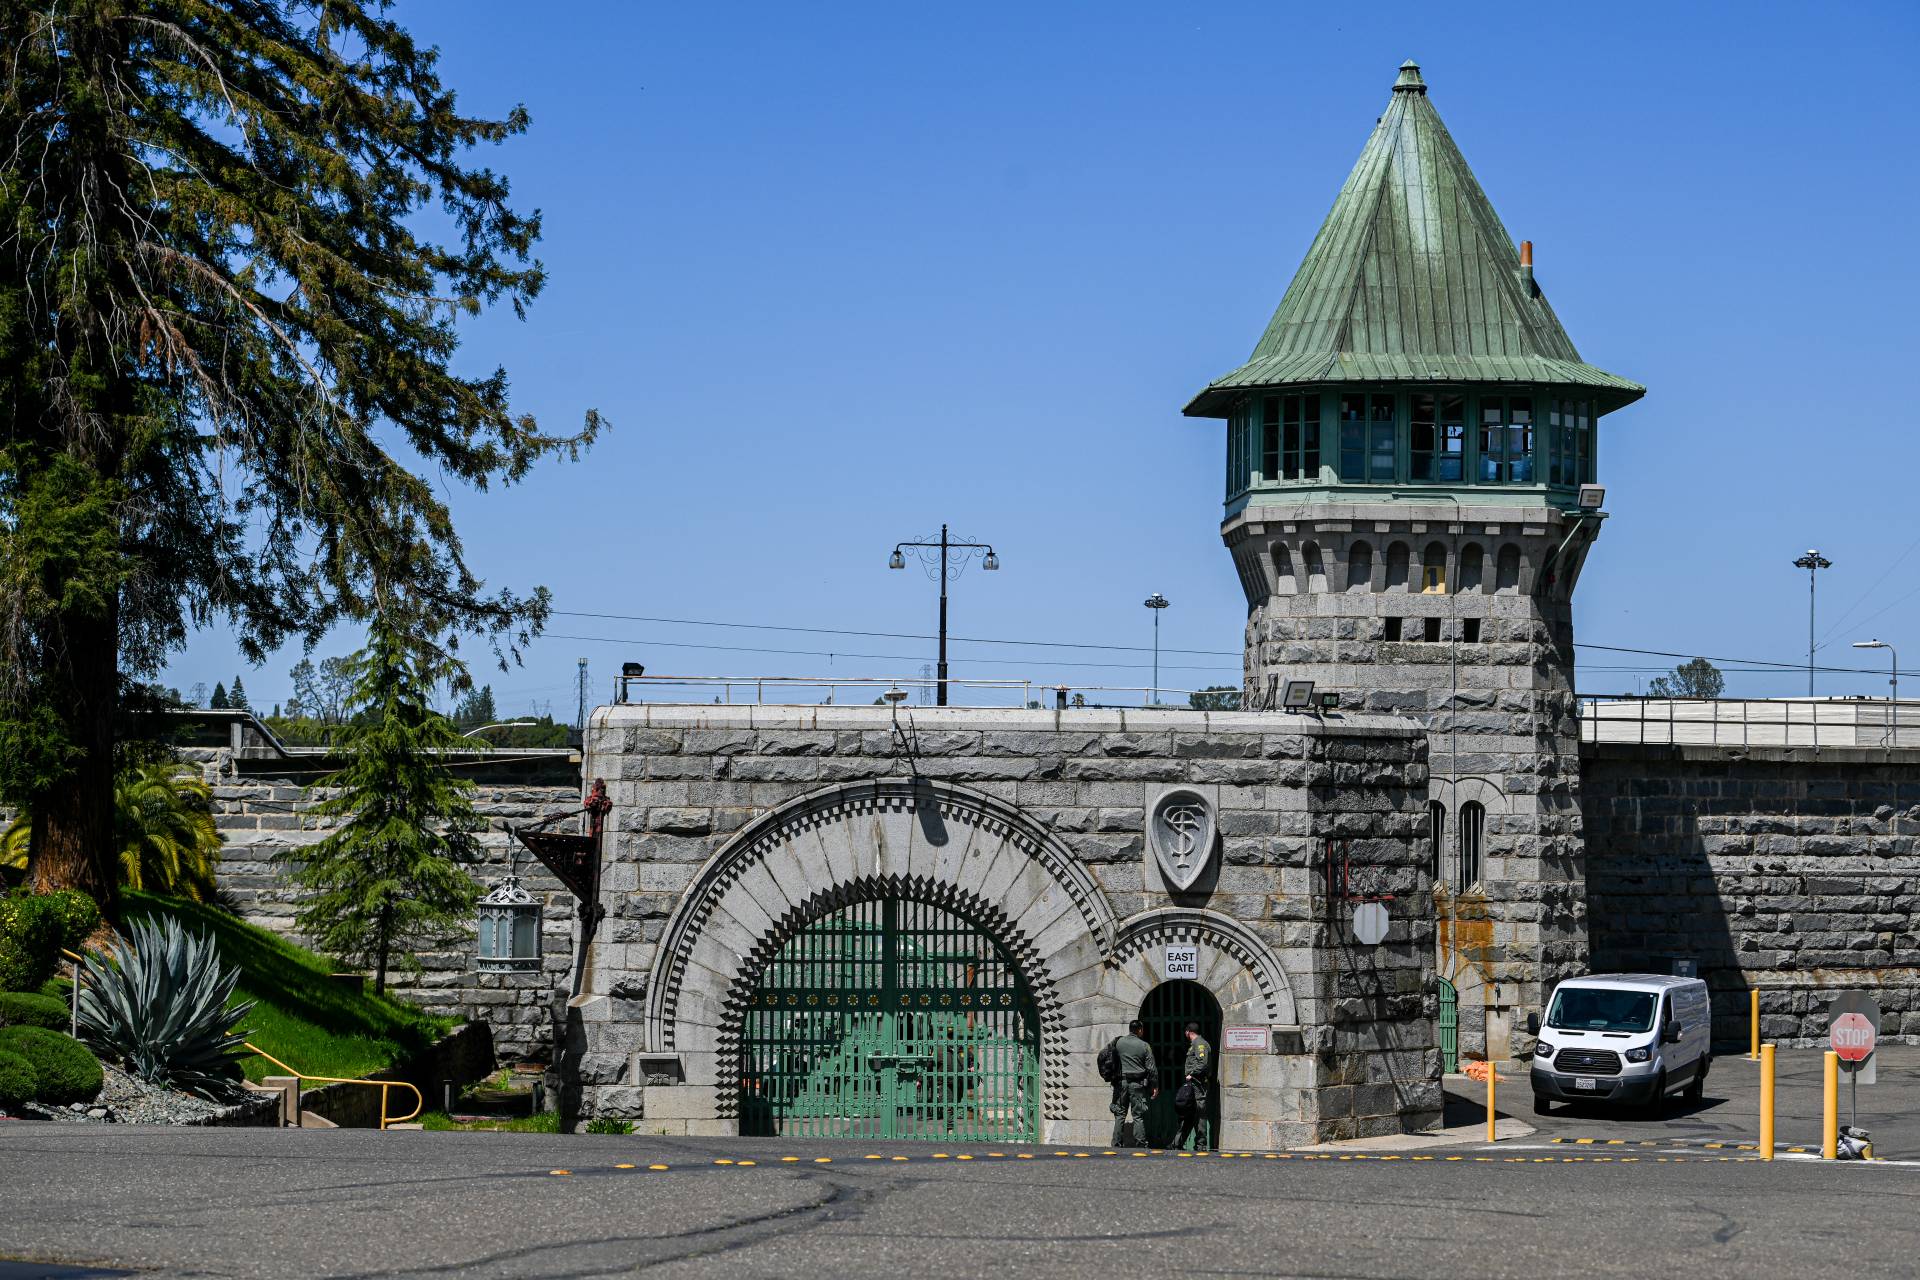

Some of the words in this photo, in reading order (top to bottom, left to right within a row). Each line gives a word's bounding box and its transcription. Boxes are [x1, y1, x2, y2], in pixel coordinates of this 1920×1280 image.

[1427, 567, 1437, 591] 1
[1167, 952, 1195, 961] EAST
[1168, 964, 1195, 973] GATE
[1836, 1028, 1869, 1046] STOP
